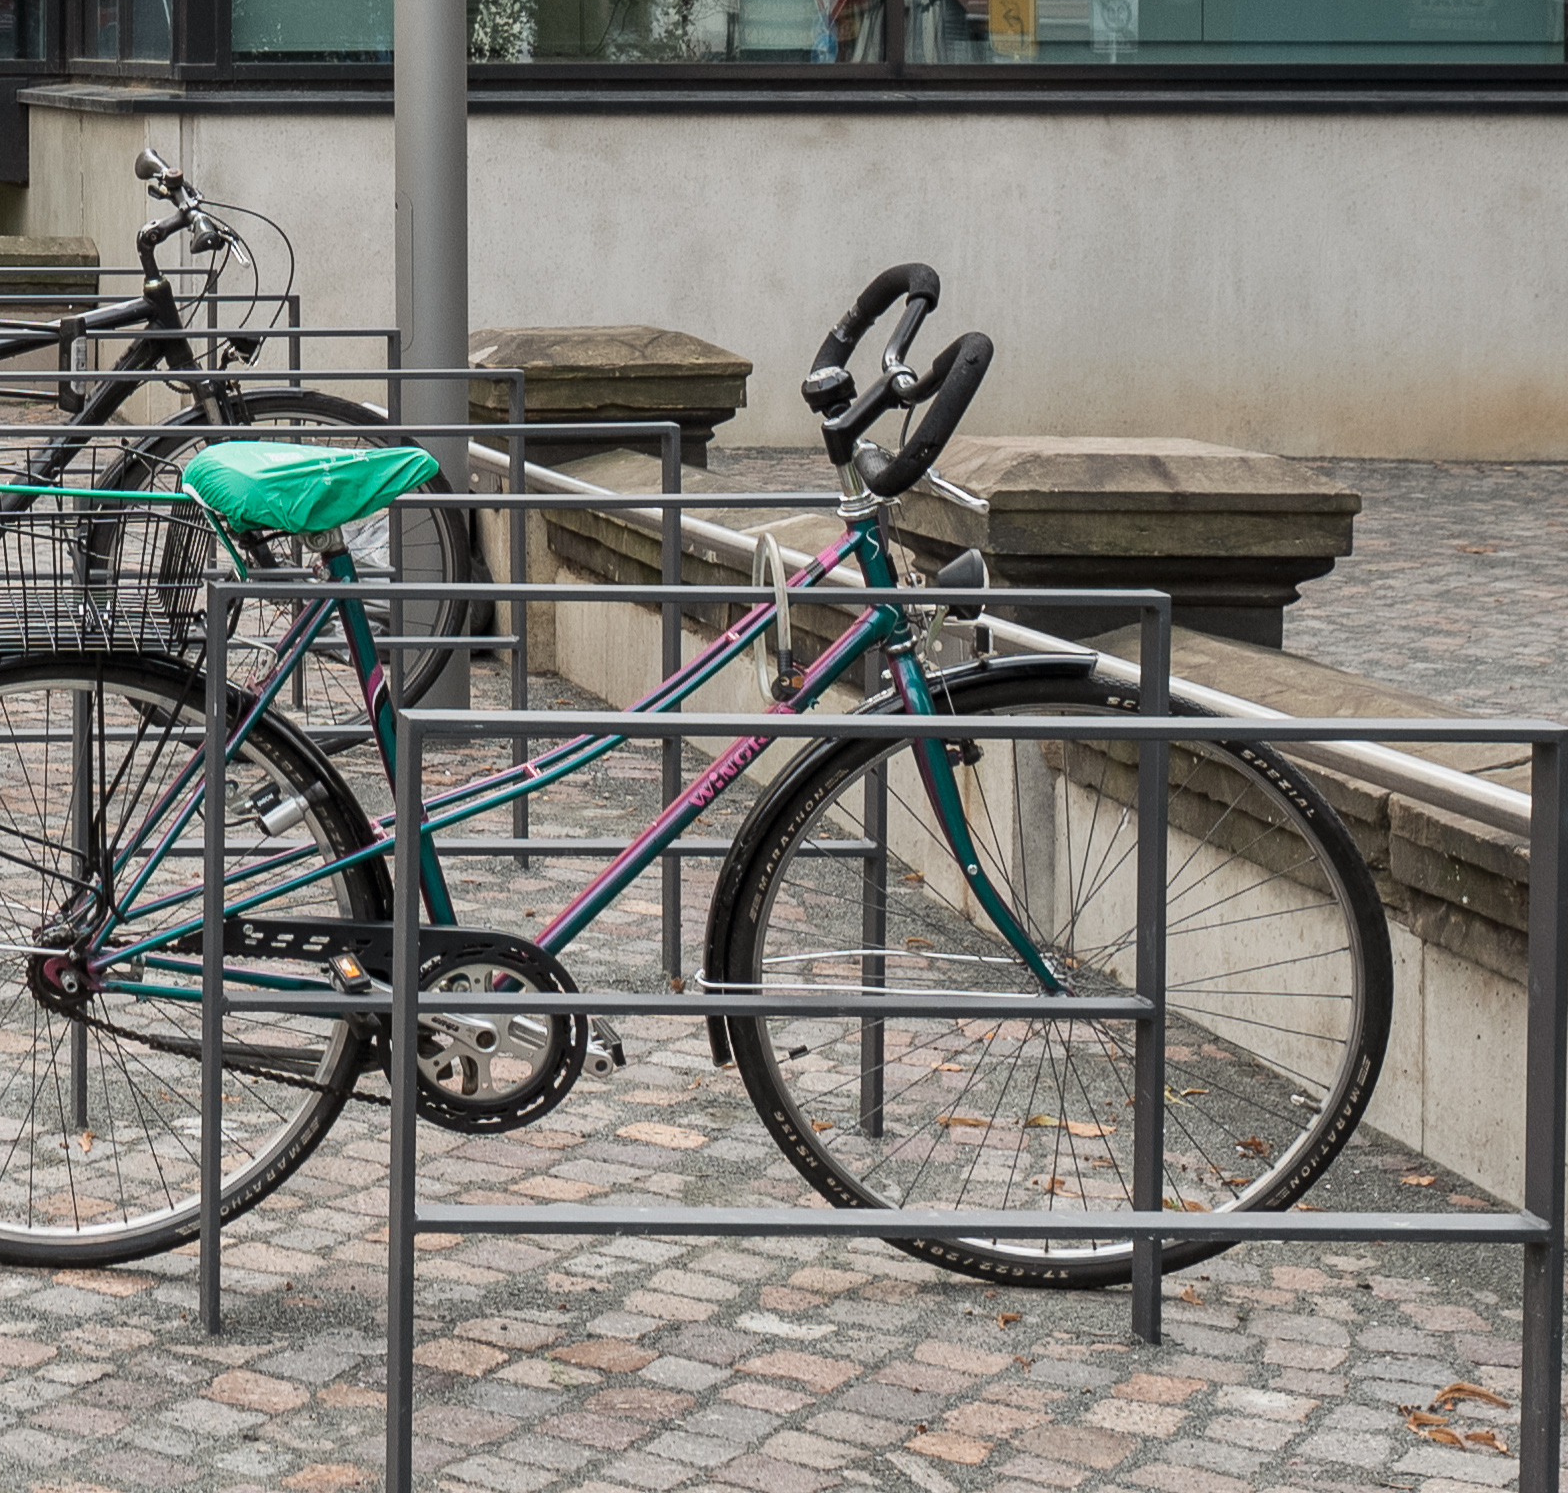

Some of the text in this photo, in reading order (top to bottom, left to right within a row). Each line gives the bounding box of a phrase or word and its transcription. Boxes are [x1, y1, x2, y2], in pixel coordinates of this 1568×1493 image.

[1240, 748, 1316, 819] SPEZIAL
[758, 786, 826, 891] MARATHON
[219, 1141, 302, 1217] MARATHO
[1289, 1085, 1361, 1188] MARATHON
